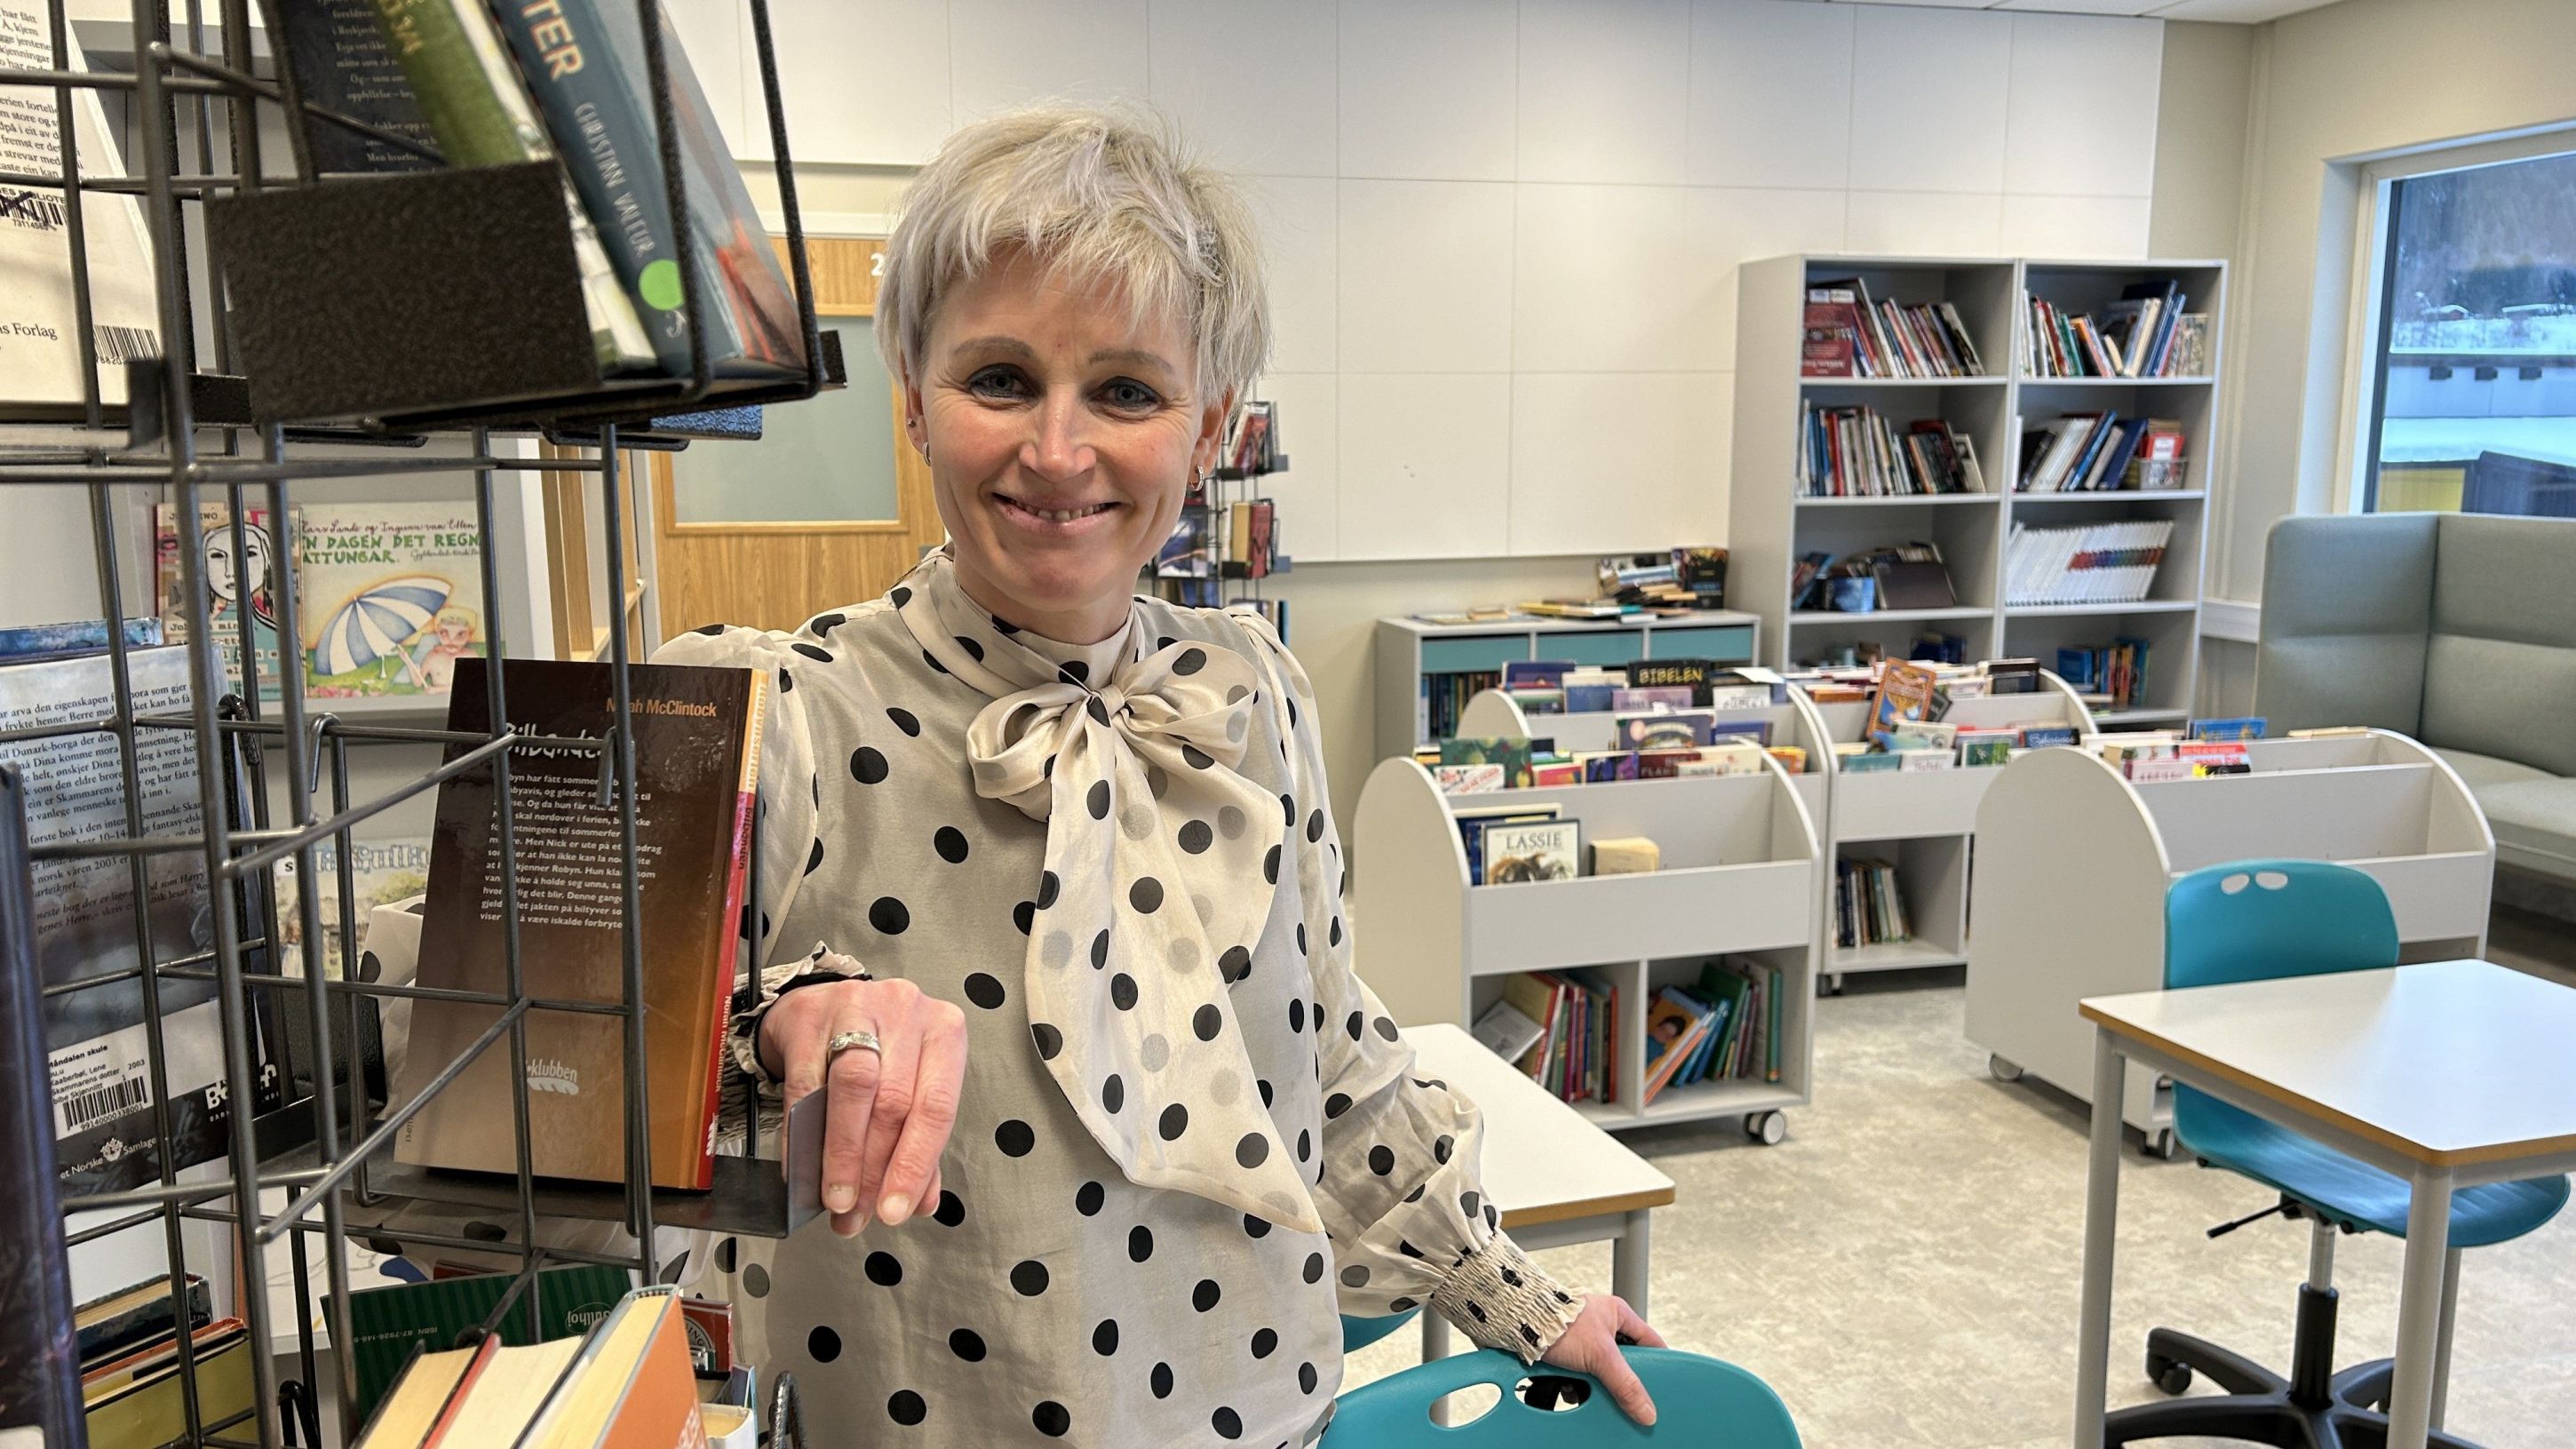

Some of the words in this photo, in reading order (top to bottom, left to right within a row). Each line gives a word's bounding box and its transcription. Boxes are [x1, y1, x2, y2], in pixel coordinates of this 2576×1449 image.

[12, 112, 36, 123] store
[38, 116, 51, 128] og
[2, 134, 34, 149] fremst
[4, 150, 38, 162] strevar
[40, 156, 61, 166] med
[575, 100, 626, 188] CHRISTIAN
[613, 191, 656, 258] VALEUR
[12, 322, 58, 340] Forlag
[327, 535, 383, 549] DAGEN
[393, 533, 425, 548] DET
[1639, 667, 1703, 684] BIBELEN
[11, 708, 32, 717] arva
[35, 704, 52, 714] den
[54, 695, 108, 711] eigenskapen
[151, 687, 169, 696] som
[171, 684, 187, 695] gjer
[69, 712, 94, 722] Berre
[96, 705, 115, 717] med
[150, 699, 166, 709] kan
[168, 697, 179, 705] ho
[182, 695, 190, 704] få
[607, 697, 642, 714] Nah
[647, 699, 717, 717] McClintock
[12, 739, 77, 758] Dunark-borga
[81, 736, 95, 745] der
[98, 733, 114, 744] den
[33, 758, 57, 768] Dina
[59, 753, 93, 762] komme
[96, 747, 119, 757] mora
[91, 760, 114, 769] Dina
[164, 747, 181, 756] vere
[34, 784, 52, 794] som
[55, 780, 72, 791] den
[75, 776, 96, 786] eldre
[163, 761, 179, 770] men
[56, 788, 113, 804] Skammarens
[145, 778, 155, 787] og
[158, 773, 172, 784] har
[175, 768, 189, 779] fått
[557, 789, 585, 799] gleder
[36, 806, 70, 821] vanlege
[74, 797, 116, 813] menneske
[149, 787, 163, 797] inn
[527, 800, 540, 809] Og
[574, 801, 587, 810] får
[535, 813, 575, 822] nordover
[583, 815, 611, 825] ferien,
[30, 830, 57, 844] første
[59, 826, 77, 838] bok
[86, 821, 101, 832] den
[1506, 831, 1562, 850] LASSIE
[546, 839, 567, 848] Nick
[599, 841, 609, 851] på
[538, 851, 555, 860] han
[579, 853, 596, 862] kan
[38, 870, 64, 884] norsk
[67, 865, 91, 877] våren
[94, 857, 116, 871] 2003
[120, 856, 128, 864] er
[515, 863, 550, 872] kjenner
[552, 864, 583, 875] Robyn.
[584, 866, 604, 875] Hun
[180, 872, 204, 885] Harry
[540, 877, 565, 886] holde
[584, 881, 608, 890] unna,
[530, 889, 545, 898] det
[547, 890, 565, 899] blir.
[567, 891, 596, 901] Denne
[530, 903, 559, 912] jakten
[561, 904, 572, 913] på
[574, 905, 609, 915] biltyver
[584, 919, 622, 930] forbryte
[722, 996, 731, 1029] Norah
[87, 1044, 107, 1055] skule
[89, 1063, 107, 1074] Lene
[715, 1031, 727, 1093] McClintock
[52, 1076, 97, 1095] Skammarens
[99, 1068, 120, 1080] dotter
[127, 1059, 146, 1071] 2003
[71, 1157, 104, 1175] Norske
[417, 1326, 438, 1335] ISBN
